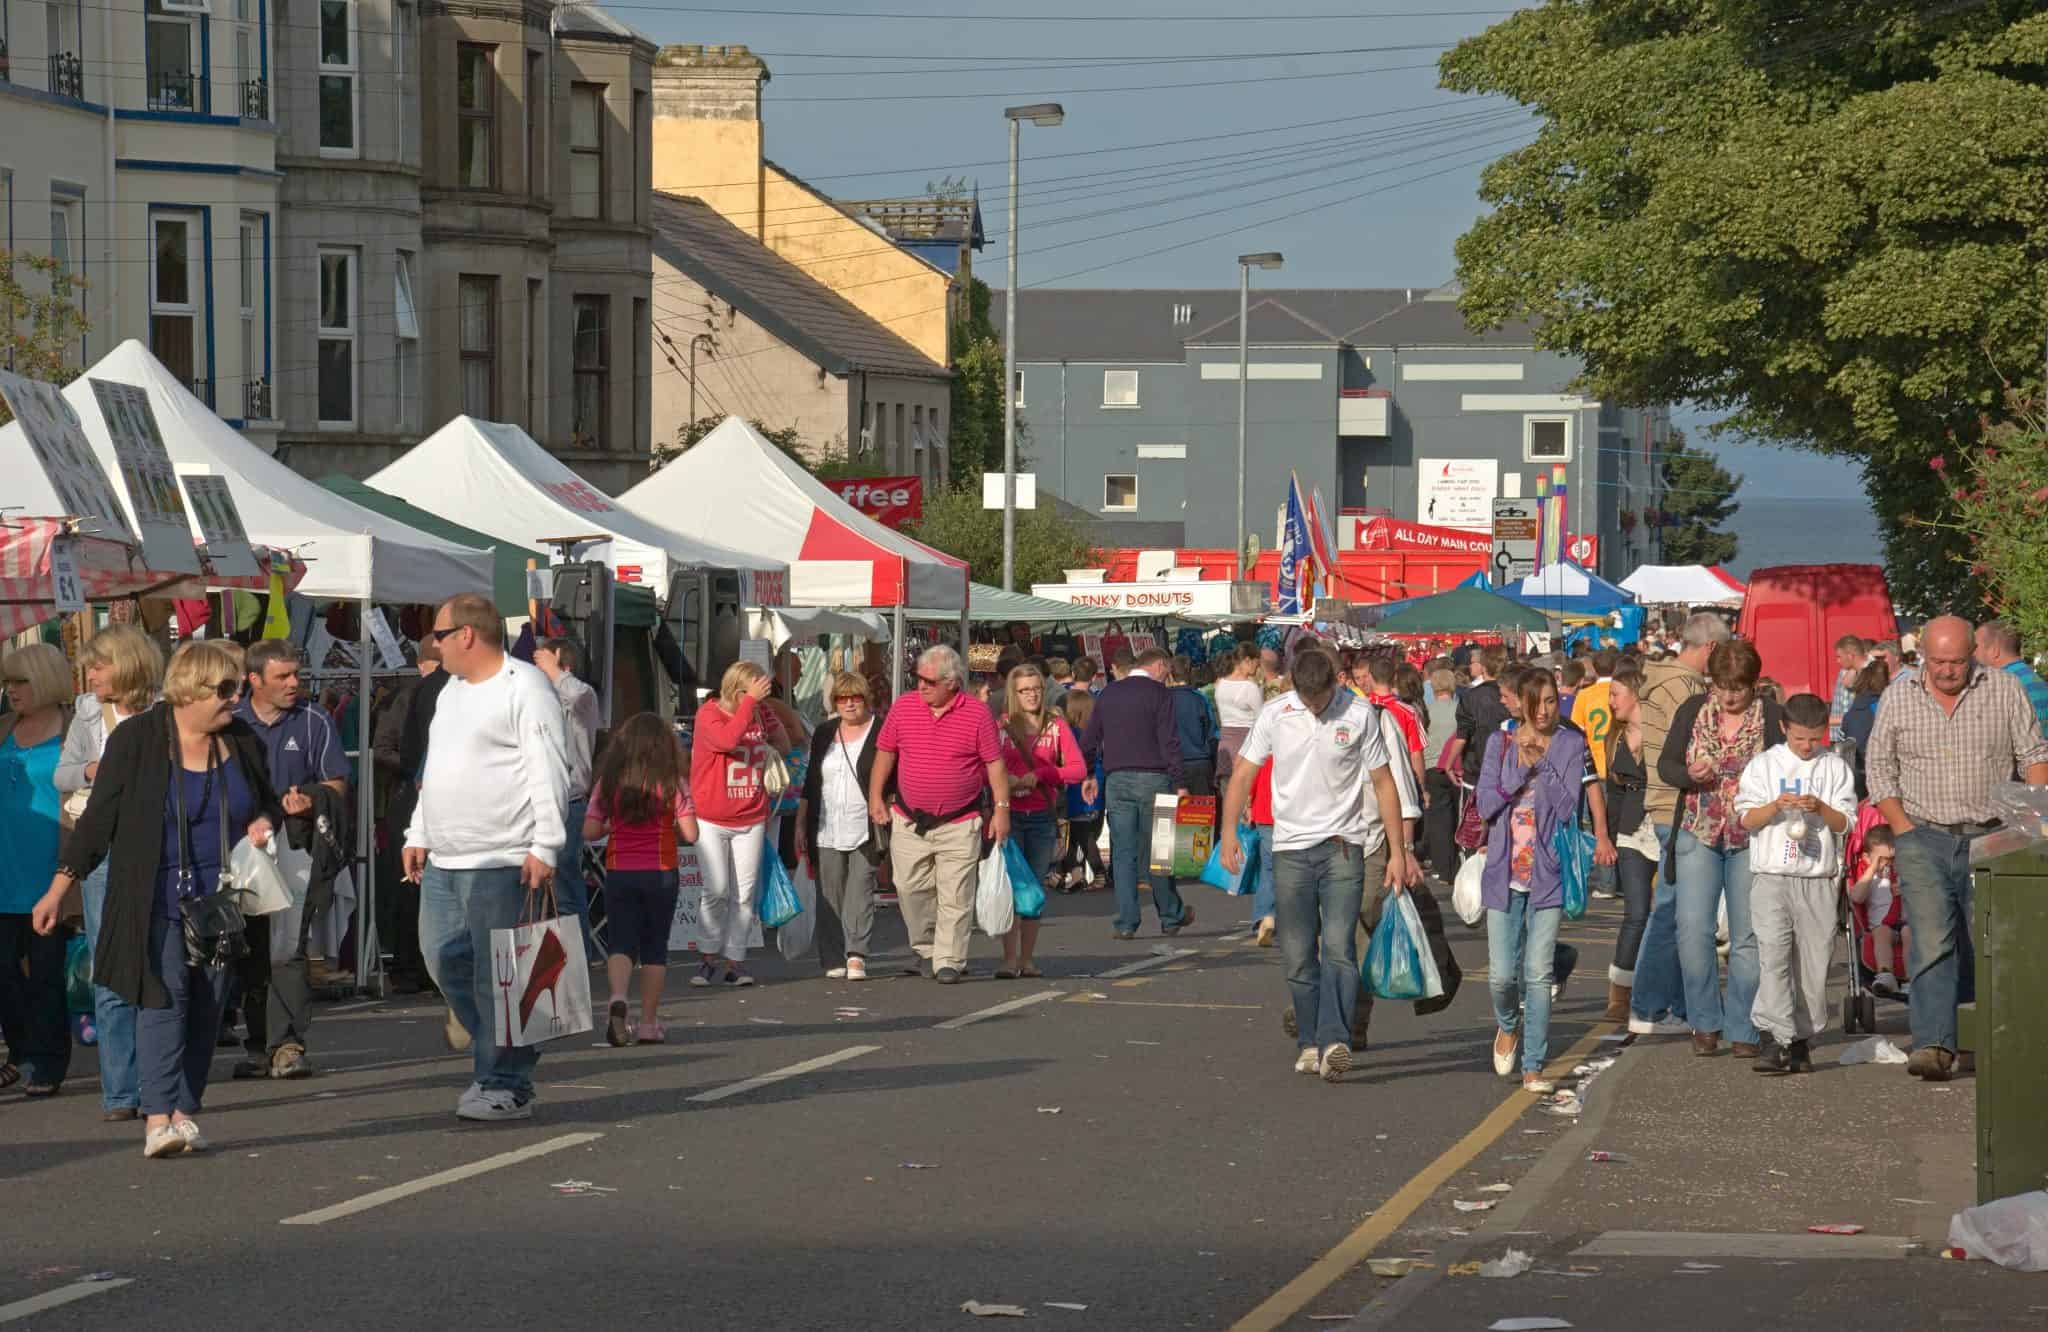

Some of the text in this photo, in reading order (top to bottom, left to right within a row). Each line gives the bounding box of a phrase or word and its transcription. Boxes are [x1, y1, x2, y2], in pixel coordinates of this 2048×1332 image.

[1394, 528, 1415, 543] ALL
[1417, 533, 1439, 546] DAY
[1440, 536, 1467, 550] MAIN
[1071, 592, 1193, 608] DINKY DONUTS
[1588, 708, 1607, 741] 2
